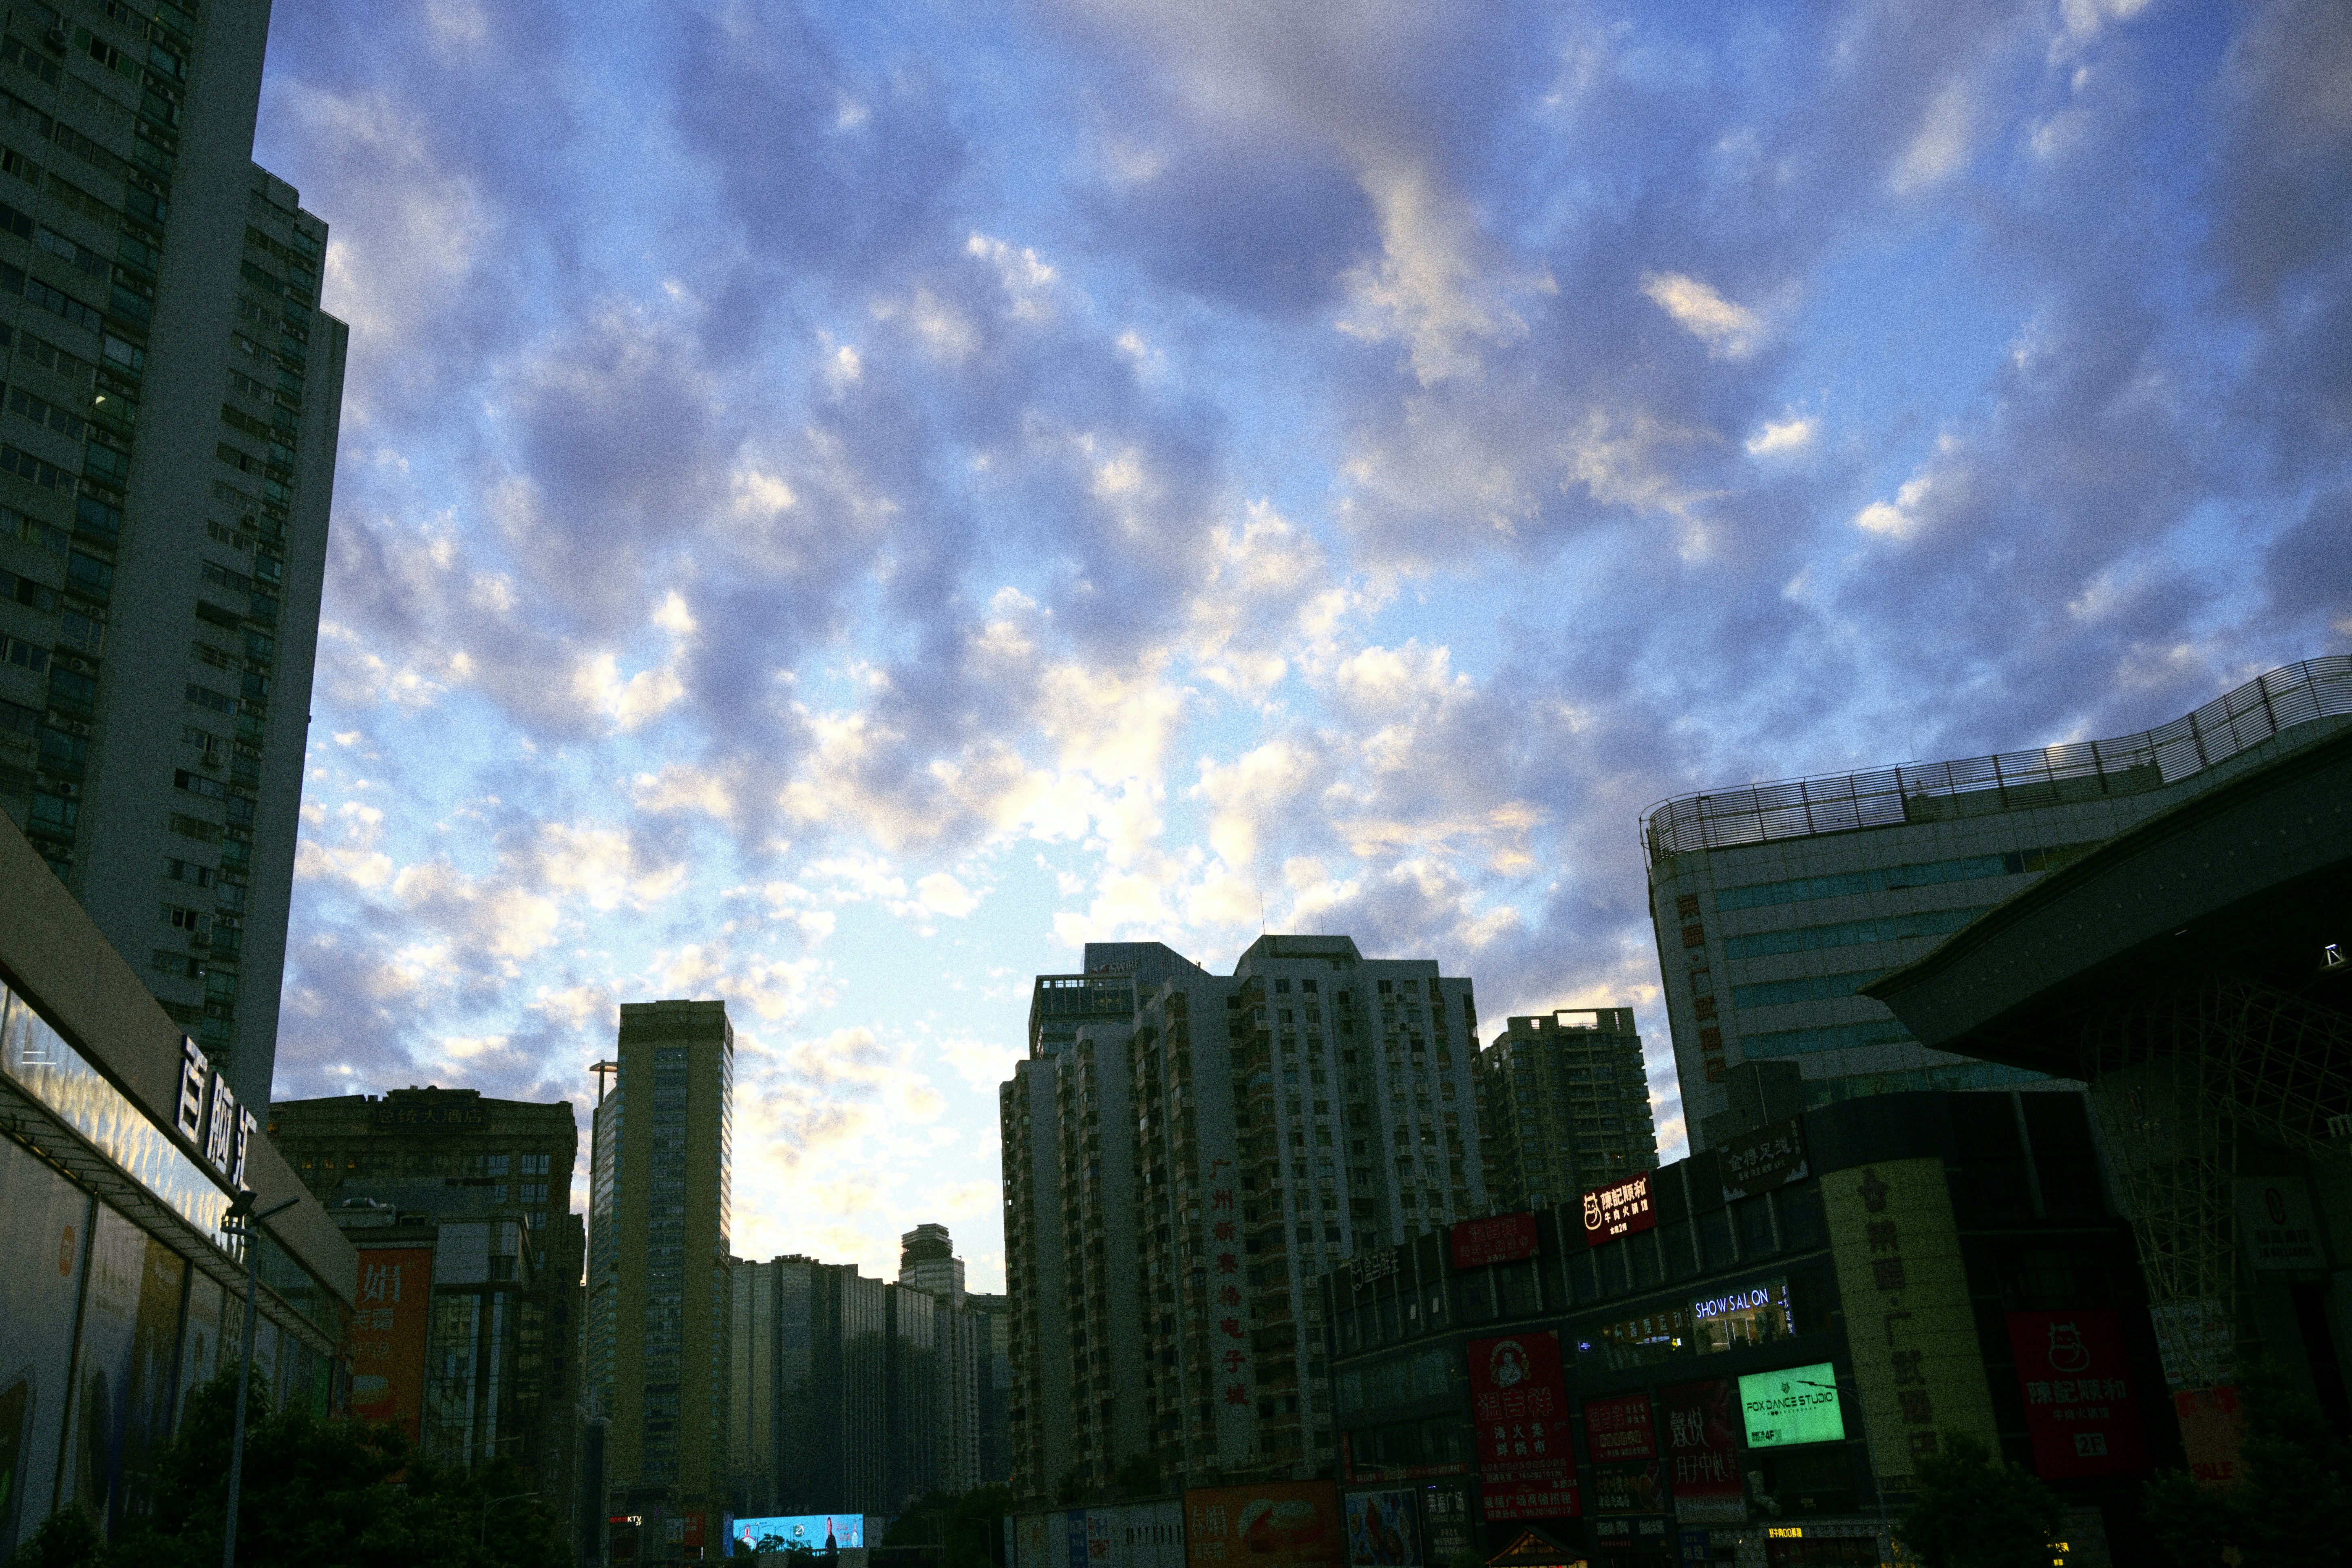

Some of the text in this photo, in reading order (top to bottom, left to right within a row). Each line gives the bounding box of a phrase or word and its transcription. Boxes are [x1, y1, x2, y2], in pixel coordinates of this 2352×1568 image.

[378, 1109, 482, 1124] 总统大酒店
[1209, 1158, 1249, 1406] 广州新赛格电子城
[1695, 1297, 1726, 1318] SHOW
[1729, 1288, 1769, 1311] SALON
[1746, 1401, 1765, 1412] FOX
[1766, 1397, 1797, 1410] DANCE
[1798, 1392, 1833, 1406] STUDIO
[1765, 1430, 1774, 1441] 4F
[2079, 1435, 2100, 1454] 2F
[2192, 1462, 2233, 1480] SALE
